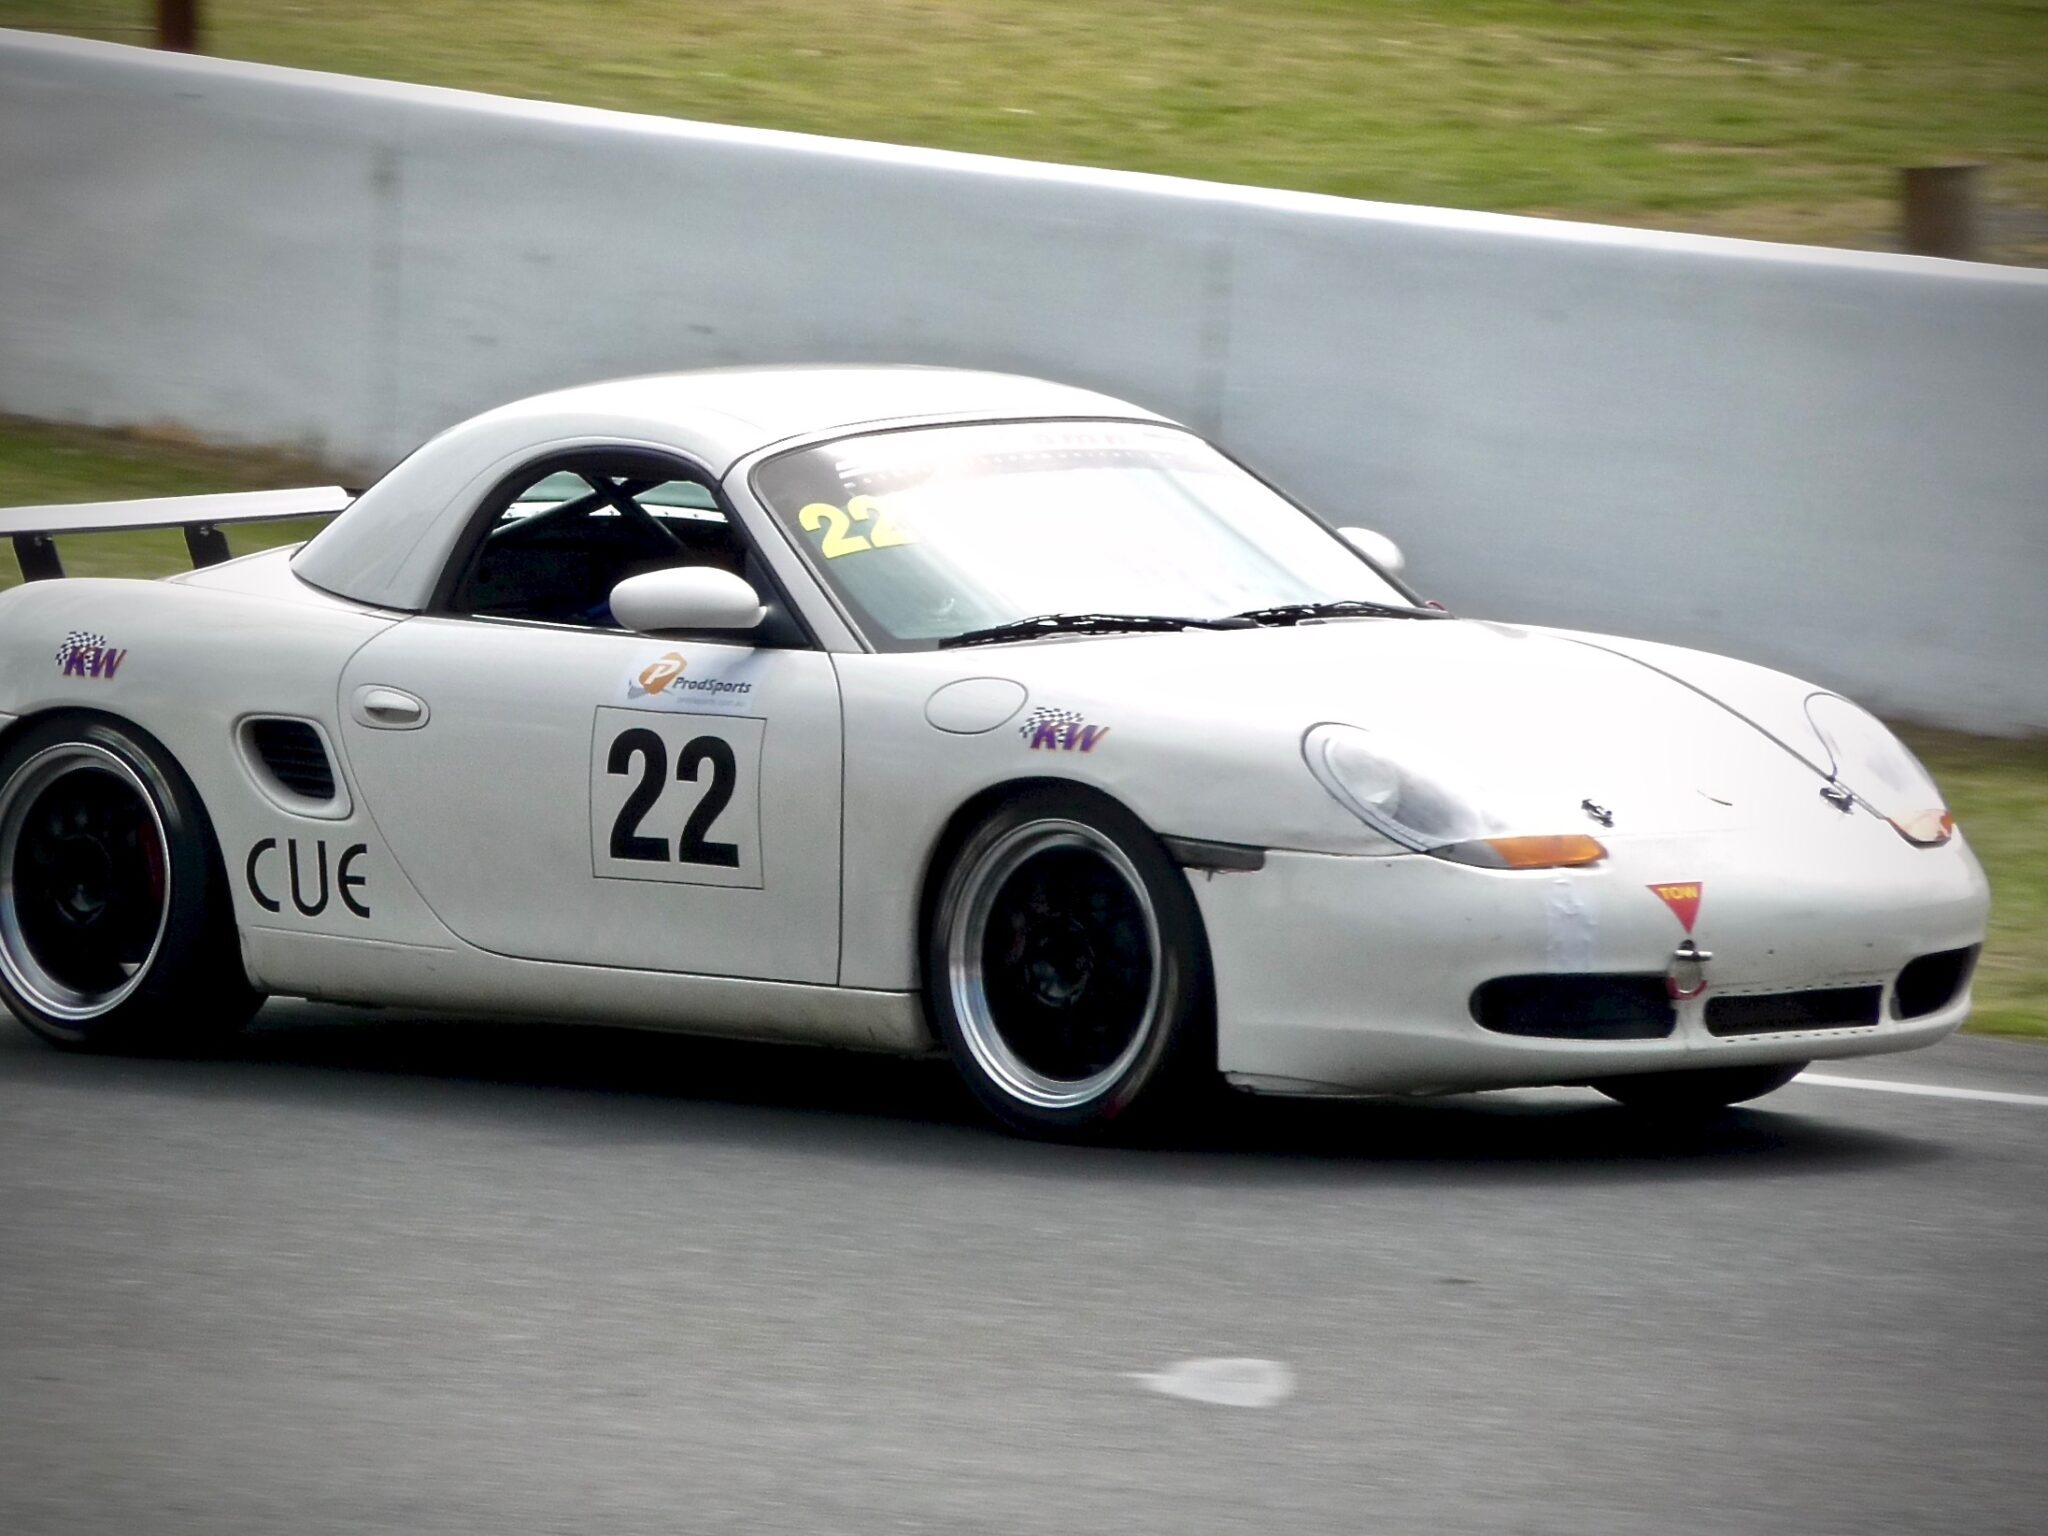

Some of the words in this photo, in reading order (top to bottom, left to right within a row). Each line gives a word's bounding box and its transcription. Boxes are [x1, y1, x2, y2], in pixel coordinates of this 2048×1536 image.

[799, 495, 919, 560] 22
[63, 645, 127, 678] KW
[673, 677, 752, 695] ProdSports
[1030, 720, 1110, 751] KW
[607, 728, 740, 868] 22
[247, 838, 370, 918] CUE
[1656, 886, 1698, 900] TOW
